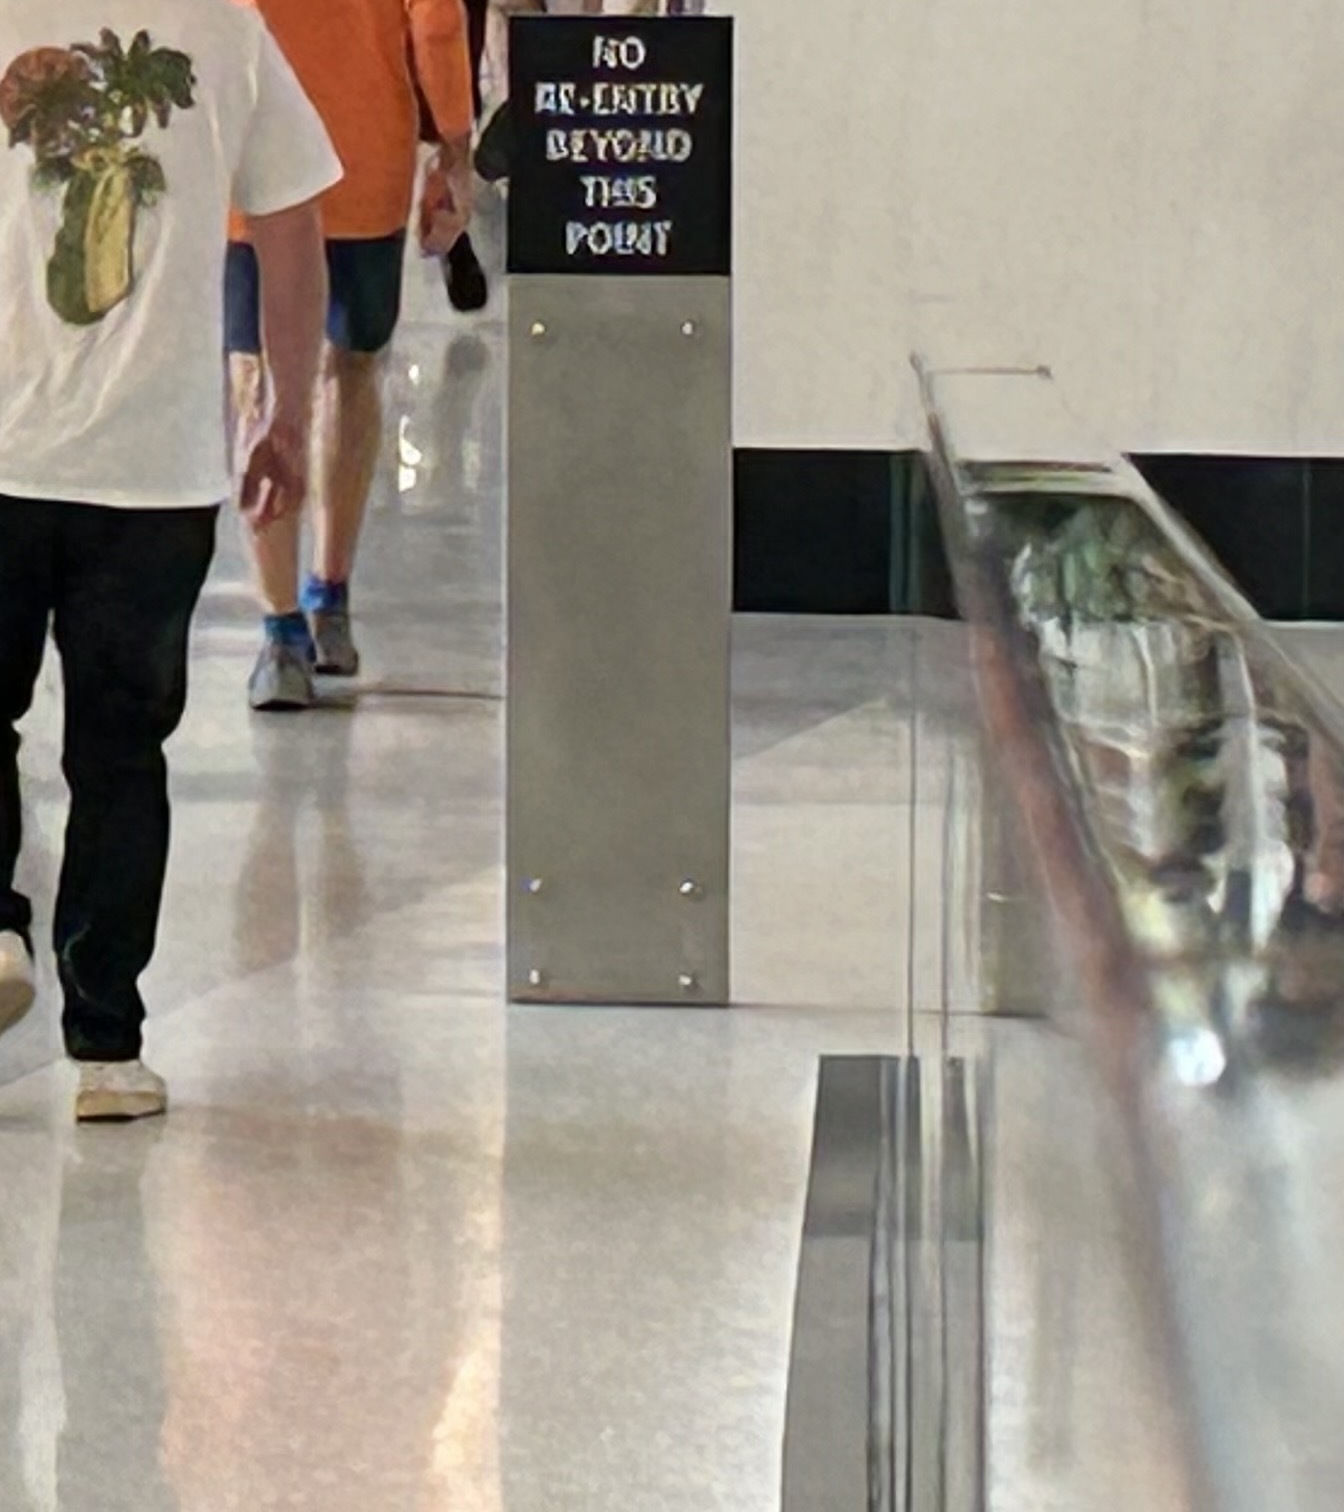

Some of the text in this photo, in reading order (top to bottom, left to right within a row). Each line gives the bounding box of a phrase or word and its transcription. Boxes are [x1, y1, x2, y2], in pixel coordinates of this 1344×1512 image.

[593, 36, 645, 69] NO
[547, 129, 691, 162] BEYOND
[581, 176, 656, 208] THIS
[566, 221, 671, 255] POINT
